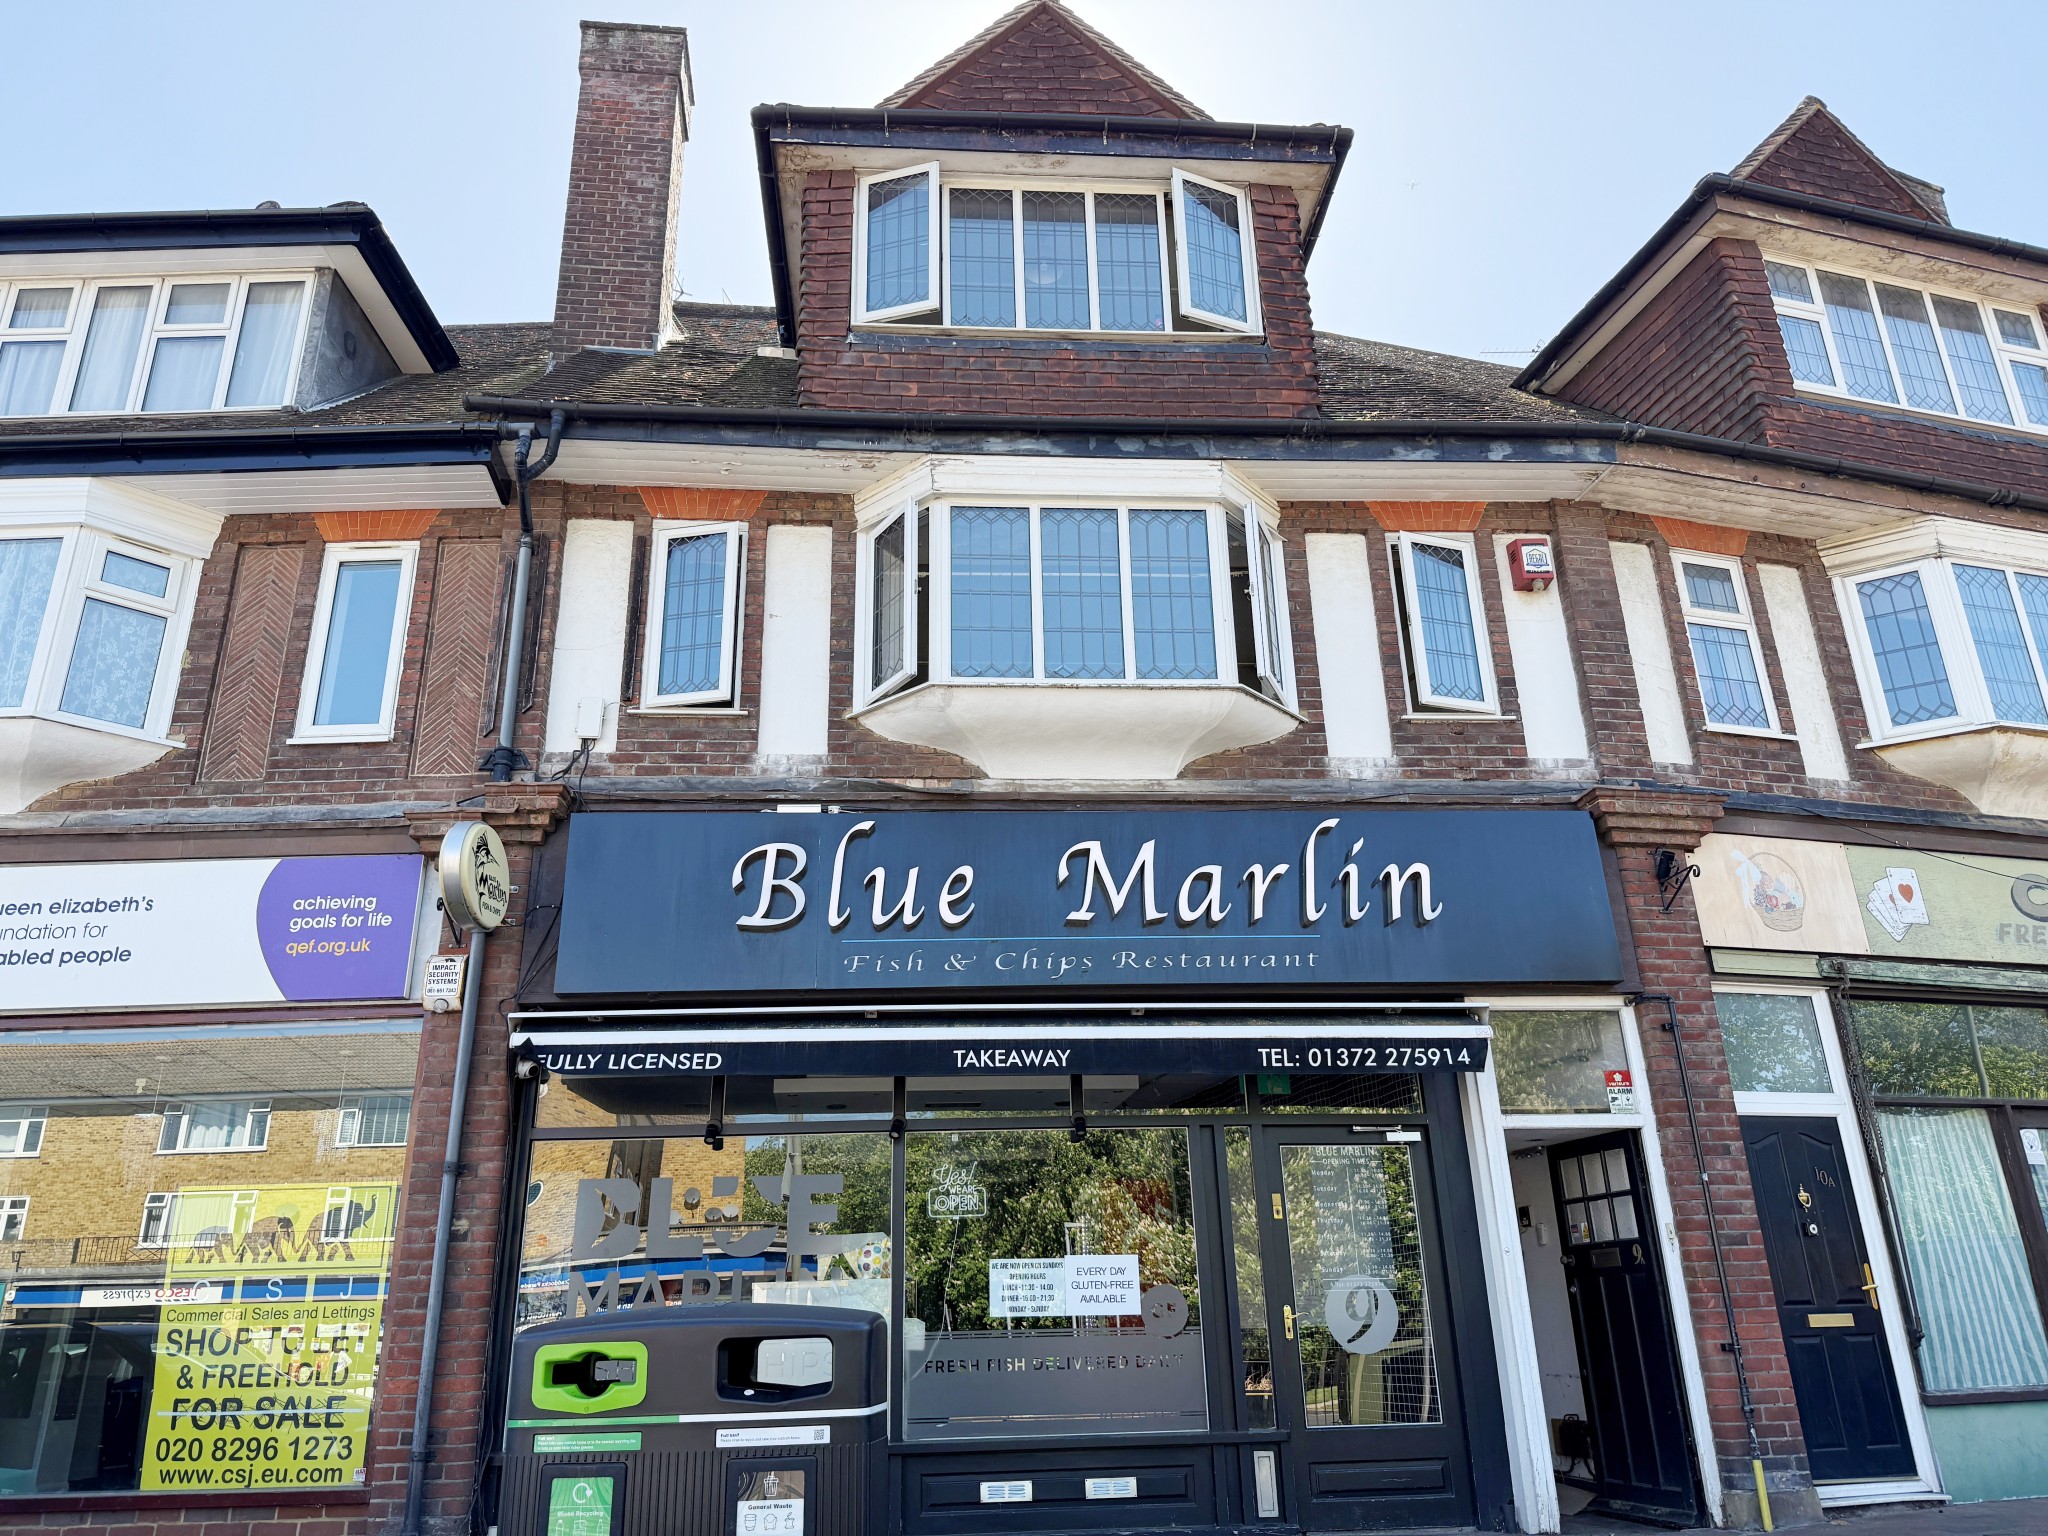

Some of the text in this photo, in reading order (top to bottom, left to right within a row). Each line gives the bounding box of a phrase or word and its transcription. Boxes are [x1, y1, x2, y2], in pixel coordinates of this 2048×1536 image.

[731, 818, 1443, 931] Blue Marlin
[292, 895, 377, 912] achieving
[82, 922, 108, 939] for
[289, 912, 392, 933] goals for life
[58, 946, 132, 967] people
[285, 938, 371, 957] qef.org.uk
[843, 947, 1320, 979] Fish & Chips Restaurant
[538, 1053, 722, 1070] FULLY LICENSED
[953, 1048, 1071, 1068] TAKEAWAY
[1258, 1047, 1471, 1067] TEL: 01372 275914
[1315, 1146, 1374, 1156] BLUE MARLIN
[933, 1161, 978, 1192] Yes!
[1311, 1169, 1334, 1177] Monday
[1814, 1166, 1836, 1187] 10A
[949, 1184, 977, 1195] WE ARE
[1313, 1185, 1337, 1193] Tuesday
[935, 1194, 979, 1211] OPEN
[1042, 1261, 1064, 1269] SUNDAYS
[1076, 1266, 1127, 1276] EVERY DAY
[193, 1276, 352, 1301] C S J
[1071, 1280, 1134, 1290] GLUTEN-FREE
[1080, 1294, 1127, 1303] AVAILABLE
[166, 1306, 375, 1323] Commercial Sales and Lettings
[1007, 1305, 1027, 1313] MONDAY
[1030, 1305, 1050, 1313] SUNDAY
[1344, 1285, 1379, 1344] 9
[165, 1327, 252, 1357] SHOP
[924, 1353, 1184, 1374] FRESH FISH DELIVERED DAILY
[176, 1362, 349, 1390] & FREEHOLD
[170, 1395, 347, 1431] FOR SALE
[155, 1435, 353, 1462] 020 8296 1273
[159, 1463, 343, 1488] www.csj.eu.com
[575, 1510, 604, 1518] Recycling
